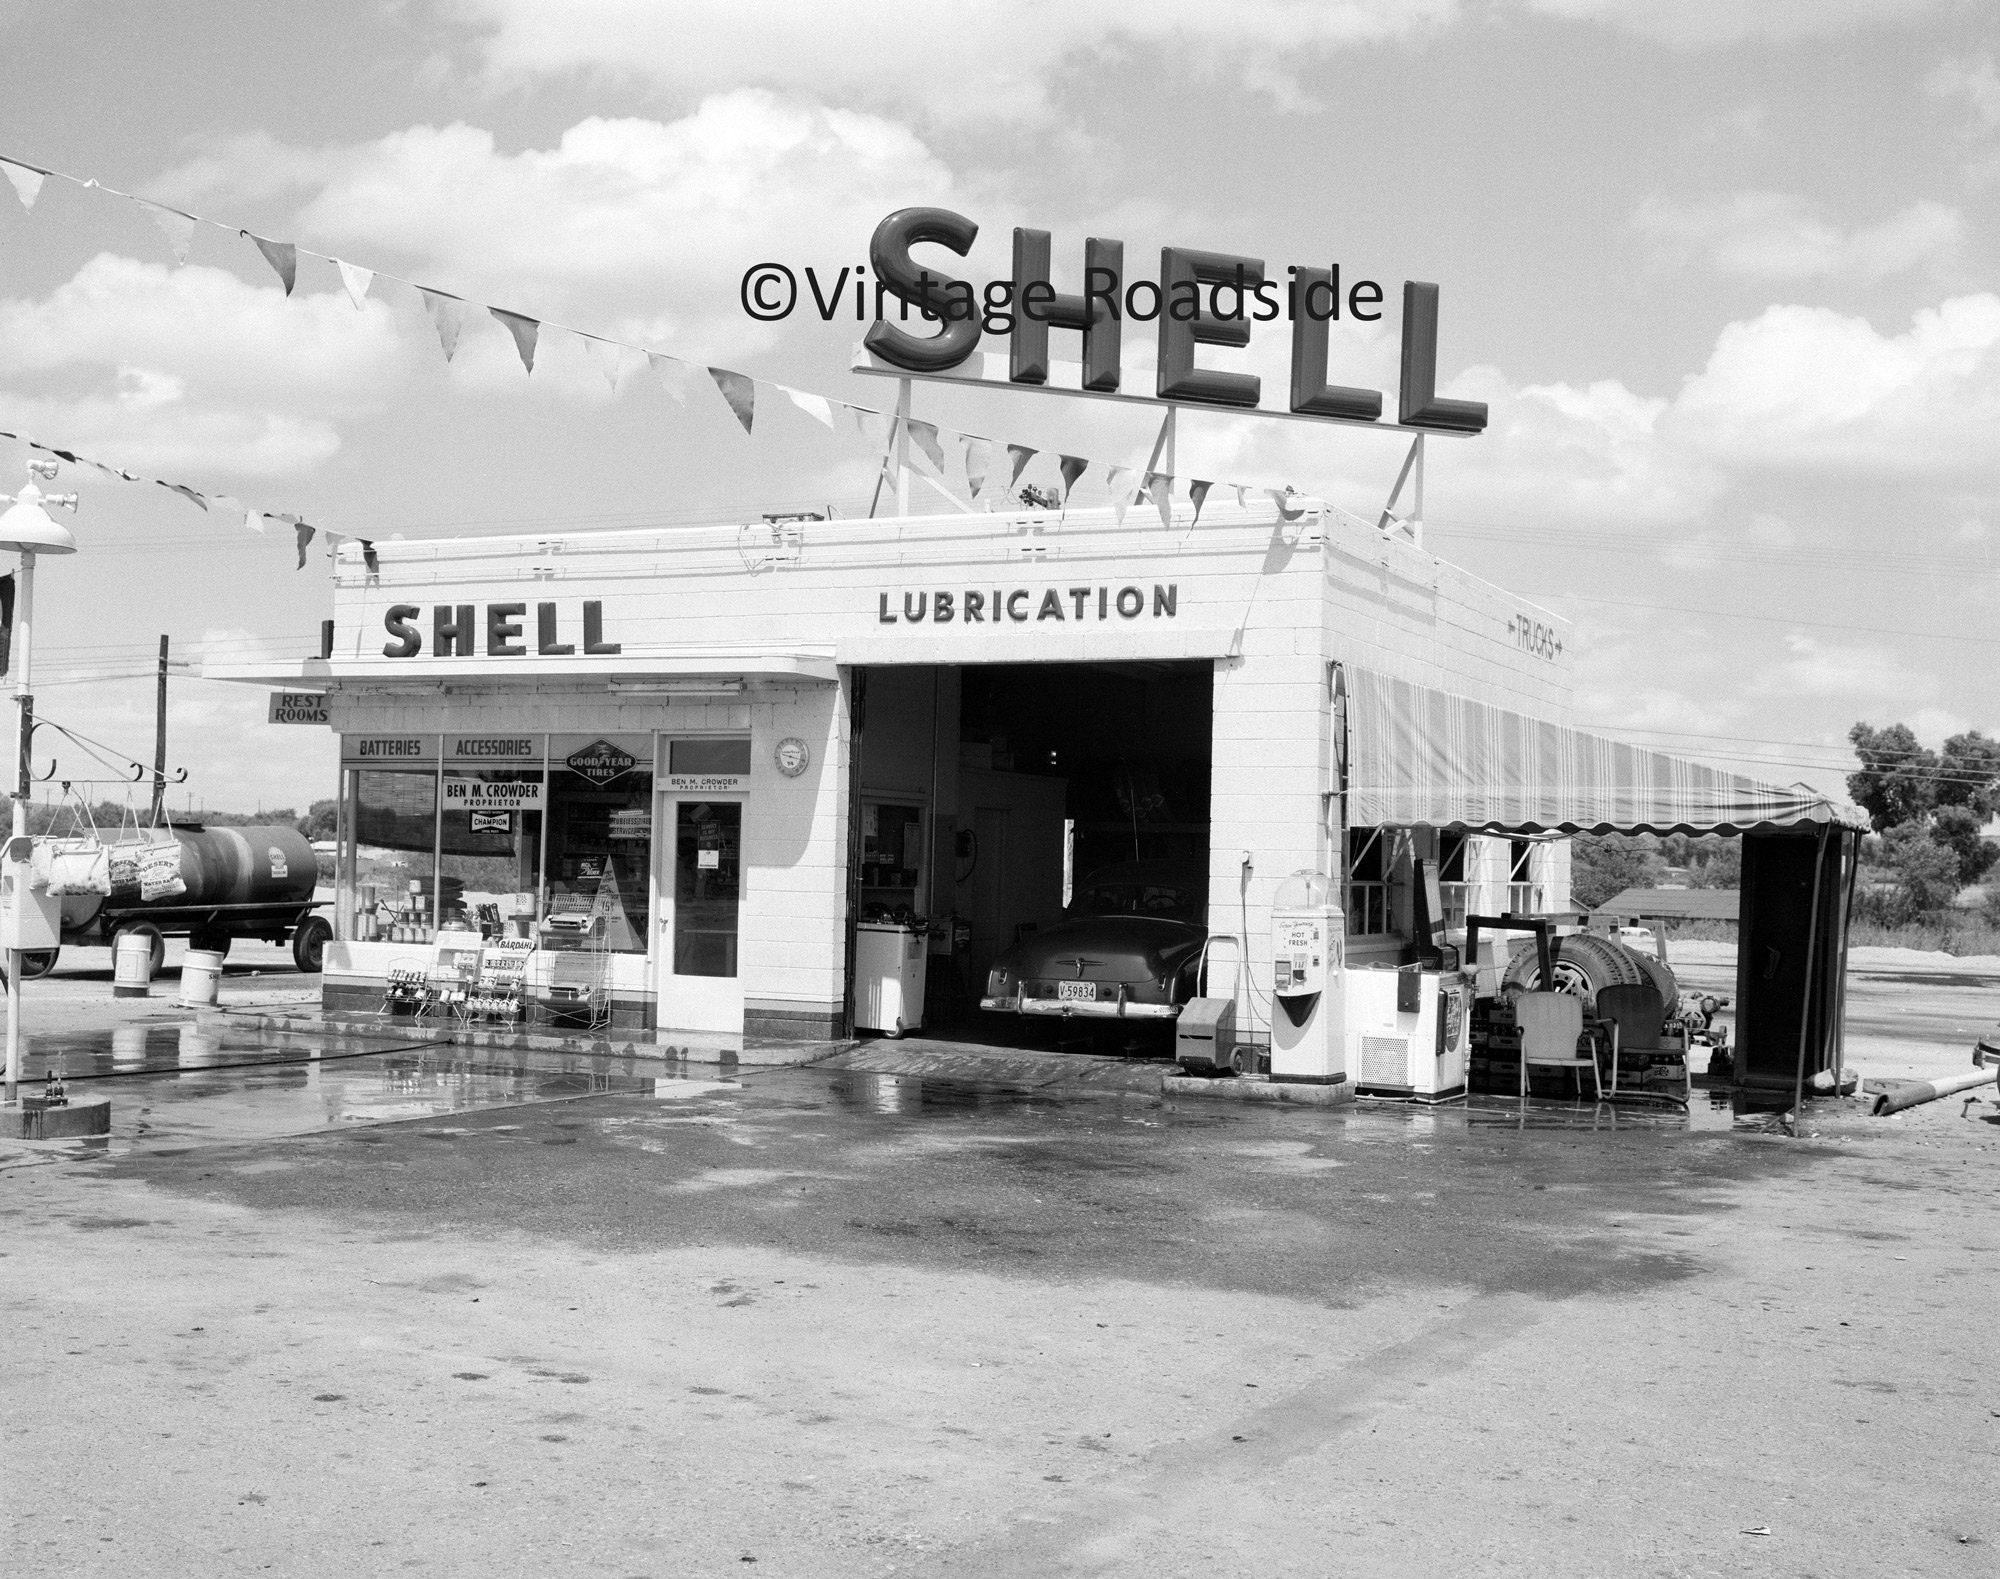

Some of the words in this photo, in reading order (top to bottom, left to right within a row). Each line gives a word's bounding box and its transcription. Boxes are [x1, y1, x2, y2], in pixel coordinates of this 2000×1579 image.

[863, 206, 1489, 432] SHELL
[879, 584, 1178, 623] LUBRICATION
[382, 600, 622, 658] SHELL
[1516, 613, 1554, 660] TRUCKS
[282, 694, 324, 709] REST
[275, 708, 328, 723] ROOMS
[359, 739, 421, 756] BATTERIES
[455, 739, 532, 756] ACCESSORIES
[586, 768, 615, 777] TIRES
[447, 784, 466, 798] BEN
[472, 784, 484, 798] M.
[487, 783, 538, 798] CROWDER
[463, 798, 521, 807] PROPRIETOR
[474, 818, 508, 826] CHAMPION
[142, 860, 174, 872] DESERT
[500, 941, 533, 950] BARDAHL
[1060, 985, 1094, 998] V-59834
